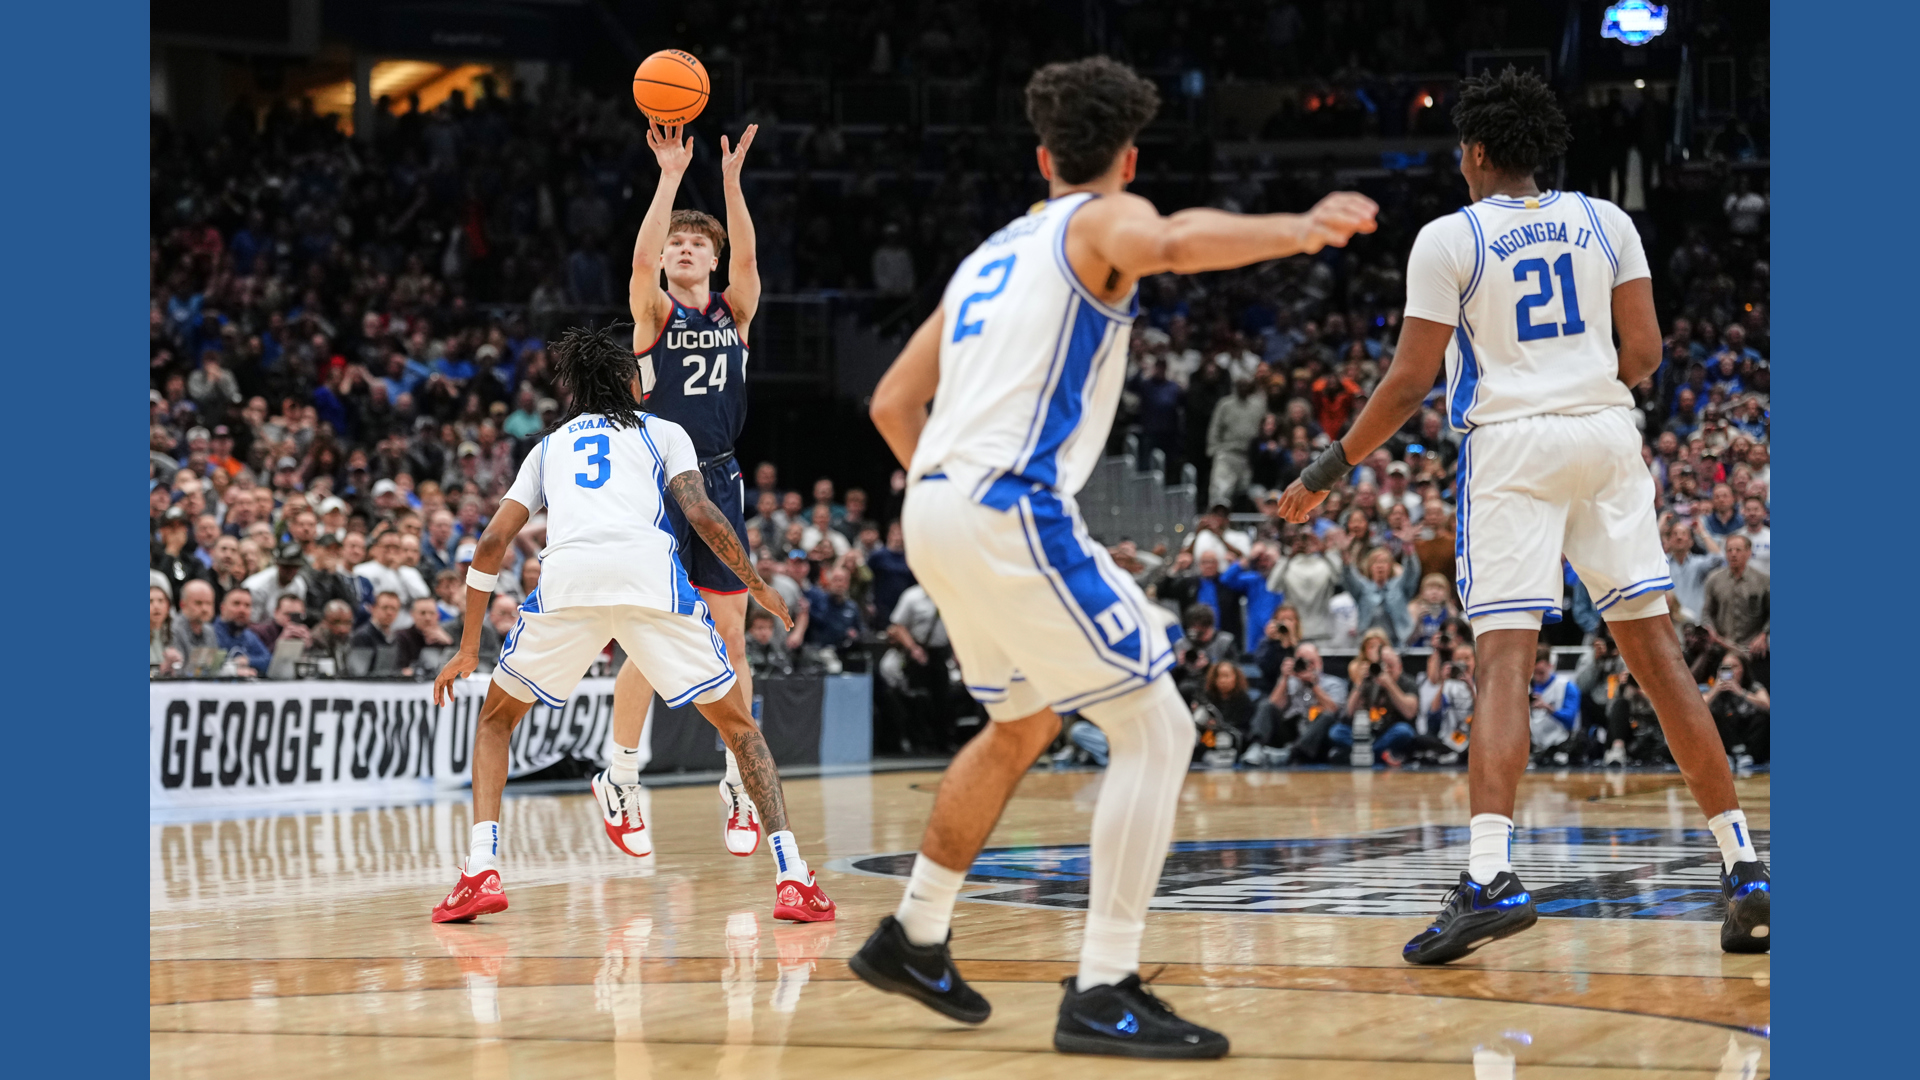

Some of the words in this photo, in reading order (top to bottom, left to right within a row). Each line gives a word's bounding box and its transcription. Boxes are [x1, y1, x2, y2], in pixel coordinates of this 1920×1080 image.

[1488, 222, 1569, 262] NGONGBA
[1574, 227, 1592, 249] II
[952, 253, 1017, 344] 2
[1513, 252, 1586, 342] 21
[667, 328, 739, 349] UCONN
[682, 353, 728, 396] 24
[573, 433, 611, 489] 3
[161, 698, 440, 789] GEORGETOWN
